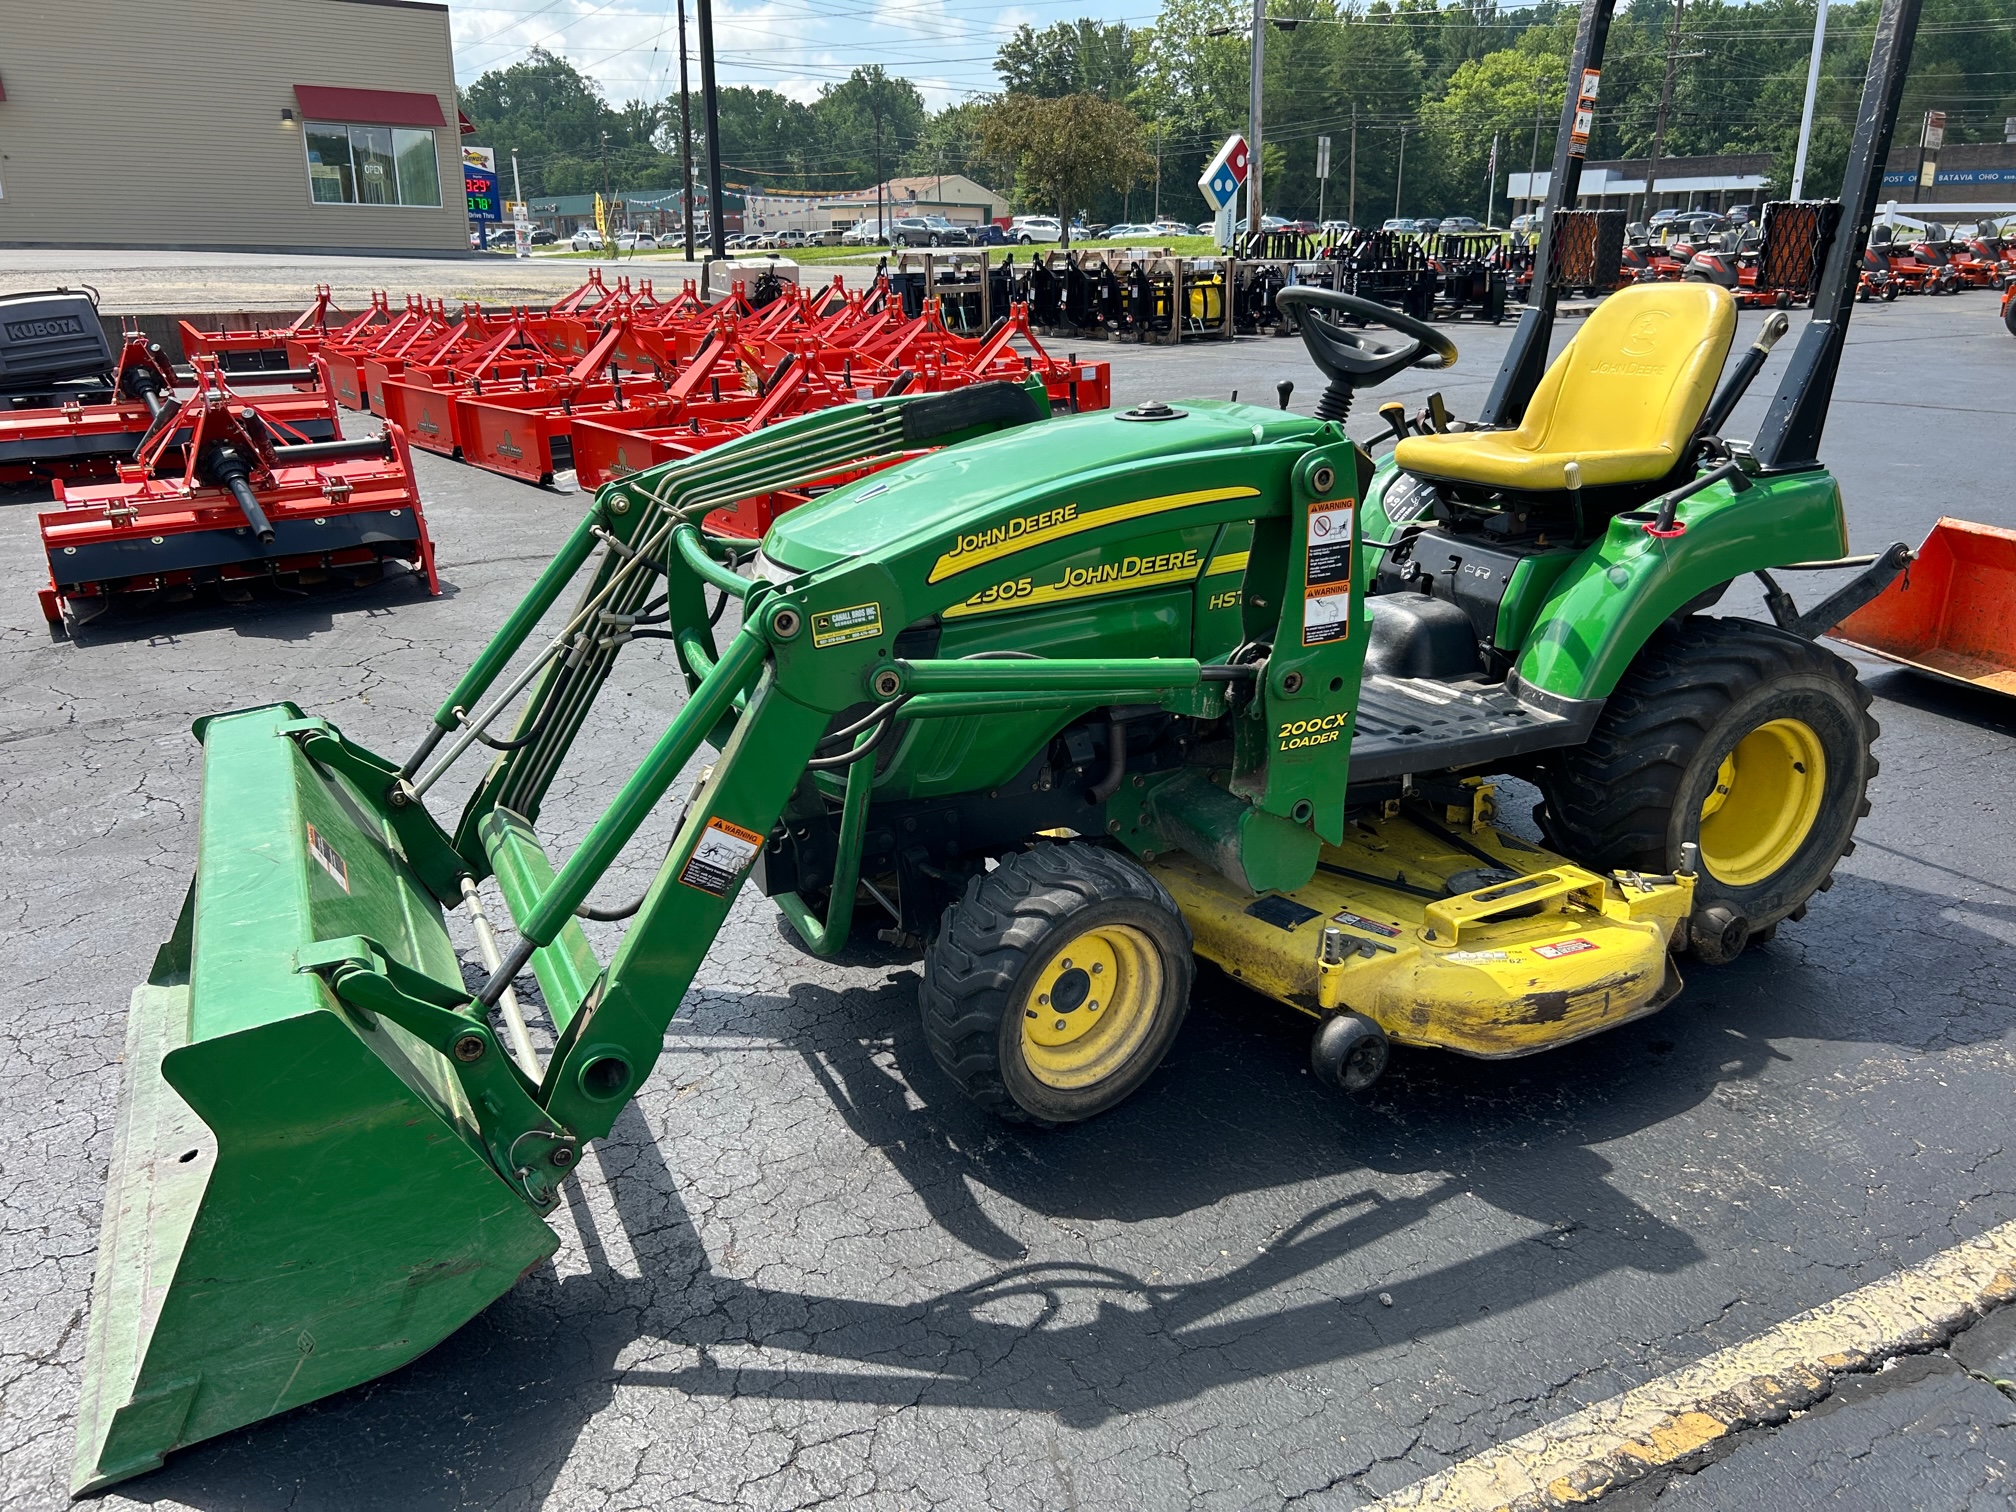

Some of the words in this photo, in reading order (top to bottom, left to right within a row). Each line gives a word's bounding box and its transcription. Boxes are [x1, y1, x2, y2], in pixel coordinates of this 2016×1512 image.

[364, 165, 383, 175] OPEN
[1978, 173, 1999, 181] OHIO
[8, 320, 80, 339] KUBOTA
[1590, 360, 1626, 374] JOHN
[1625, 361, 1667, 376] DEERE
[1317, 500, 1353, 512] WARNING
[949, 525, 1006, 557] JOHN
[1008, 503, 1077, 538] DEERE
[1054, 562, 1119, 589] JOHN
[1121, 549, 1198, 578] DEERE
[1313, 584, 1348, 596] WARNING
[1278, 711, 1349, 738] 200CX
[1280, 730, 1340, 751] LOADER
[724, 824, 758, 843] WARNING
